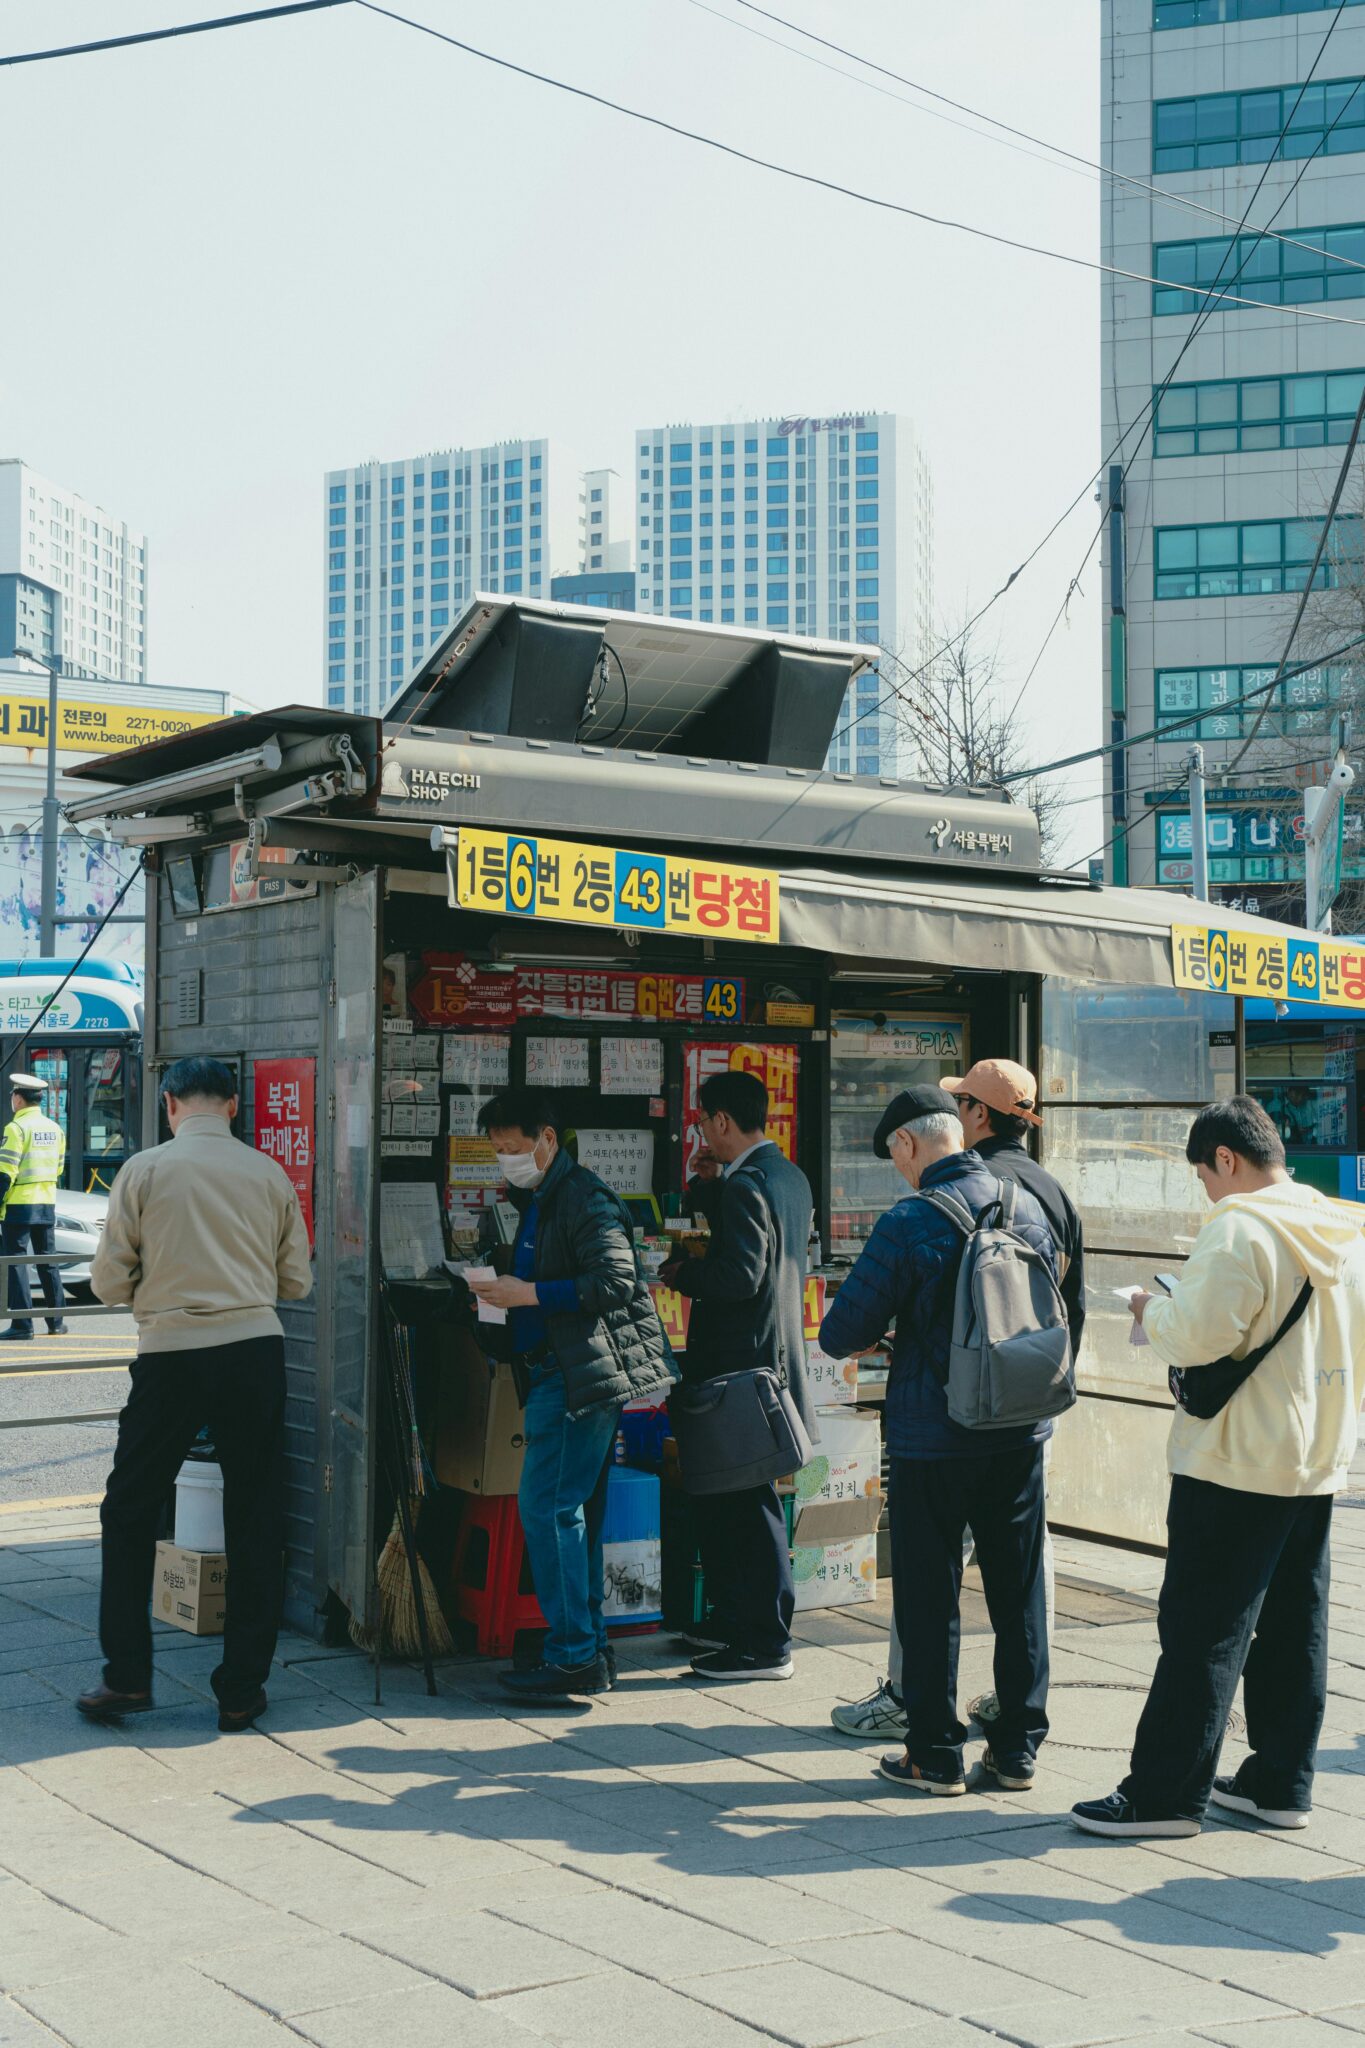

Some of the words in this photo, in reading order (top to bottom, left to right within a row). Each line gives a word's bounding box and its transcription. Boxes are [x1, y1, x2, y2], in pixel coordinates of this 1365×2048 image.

[63, 708, 108, 728] 전문의
[126, 716, 192, 733] 2271-0020
[411, 768, 481, 789] HAECHI
[411, 785, 450, 801] SHOP
[952, 830, 1012, 853] 서울특별시
[1169, 863, 1189, 878] 3F
[264, 880, 280, 893] PASS
[517, 972, 608, 993] 자동5번
[8, 996, 31, 1012] 타고
[8, 1013, 31, 1029] 쉬는
[84, 1018, 109, 1028] 7278
[267, 1080, 300, 1122] 복권
[163, 1569, 186, 1592] 하늘보리
